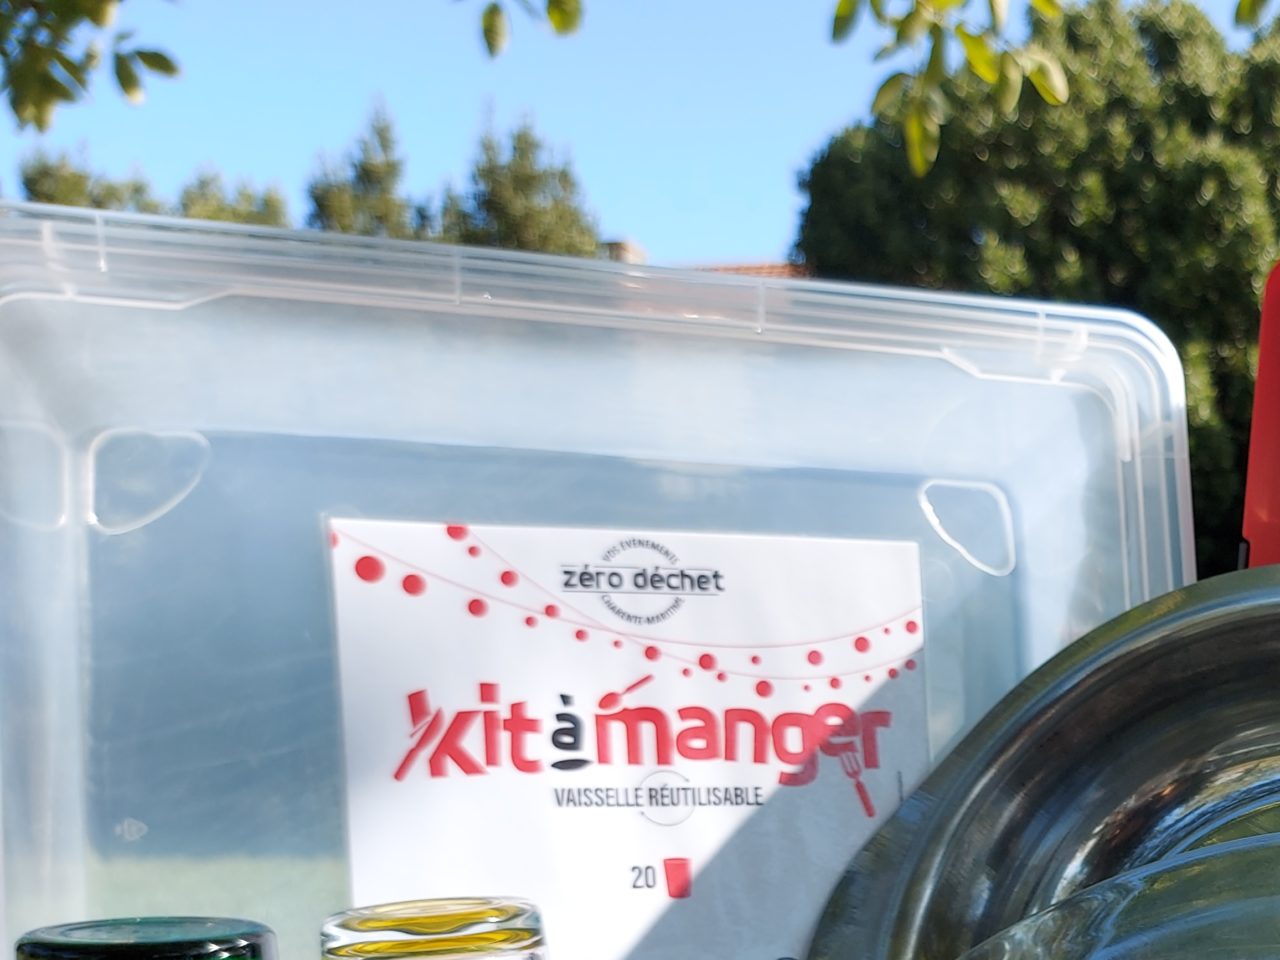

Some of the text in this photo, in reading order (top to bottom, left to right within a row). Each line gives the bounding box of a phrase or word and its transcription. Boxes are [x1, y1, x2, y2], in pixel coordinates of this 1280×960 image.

[562, 564, 725, 591] zéro déchet
[553, 784, 765, 808] VAISSELLE RÉUTILISABLE
[631, 866, 657, 890] 20
